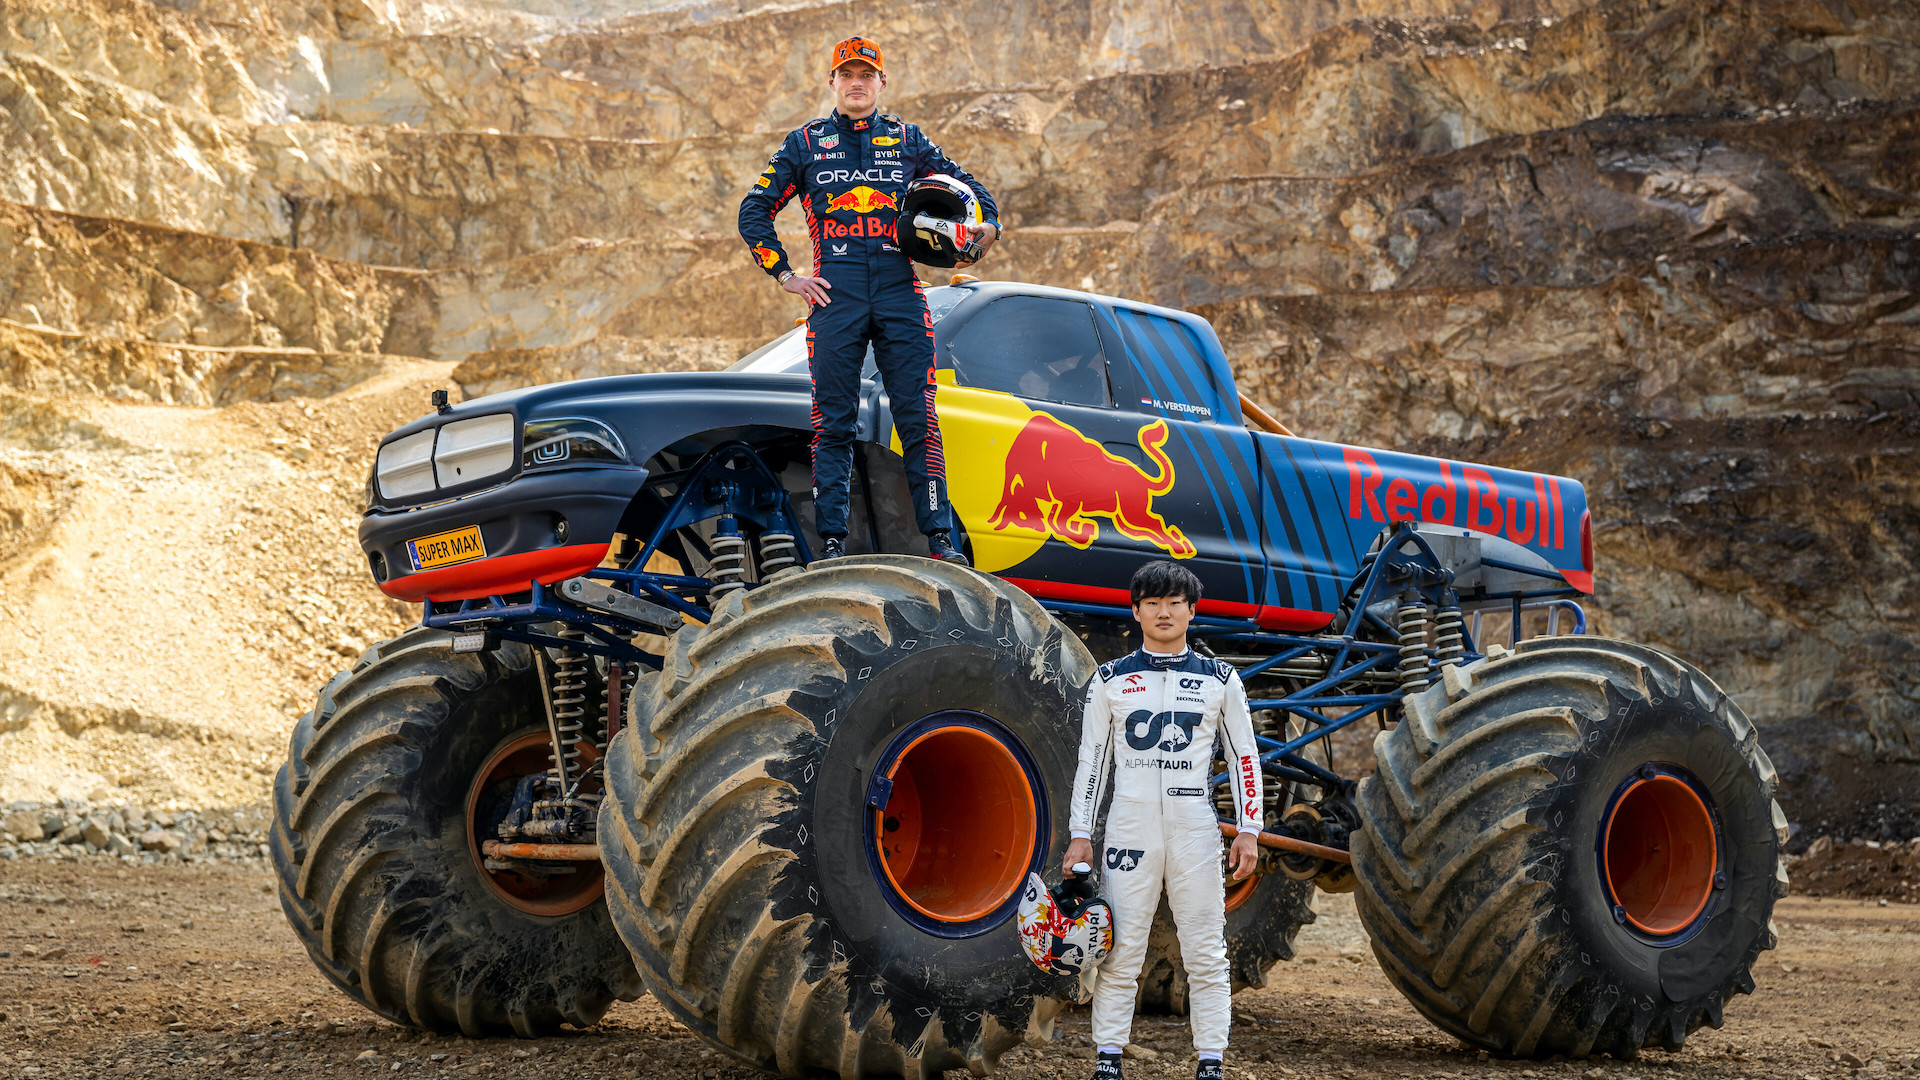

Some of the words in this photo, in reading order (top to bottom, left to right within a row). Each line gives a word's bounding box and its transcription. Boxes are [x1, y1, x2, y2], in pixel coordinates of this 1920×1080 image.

[814, 152, 836, 160] Mobil
[874, 149, 900, 158] BYBIT
[816, 169, 904, 184] ORACLE
[823, 216, 864, 240] Red
[1153, 400, 1164, 410] M.
[1163, 400, 1212, 416] VERSTAPPEN
[1342, 446, 1457, 524] Red
[1460, 466, 1565, 550] Bull
[418, 541, 450, 562] SUPER
[450, 534, 480, 556] MAX
[1122, 686, 1146, 694] ORLEN
[1125, 758, 1192, 770] ALPHATAURI
[1240, 756, 1256, 798] ORLEN
